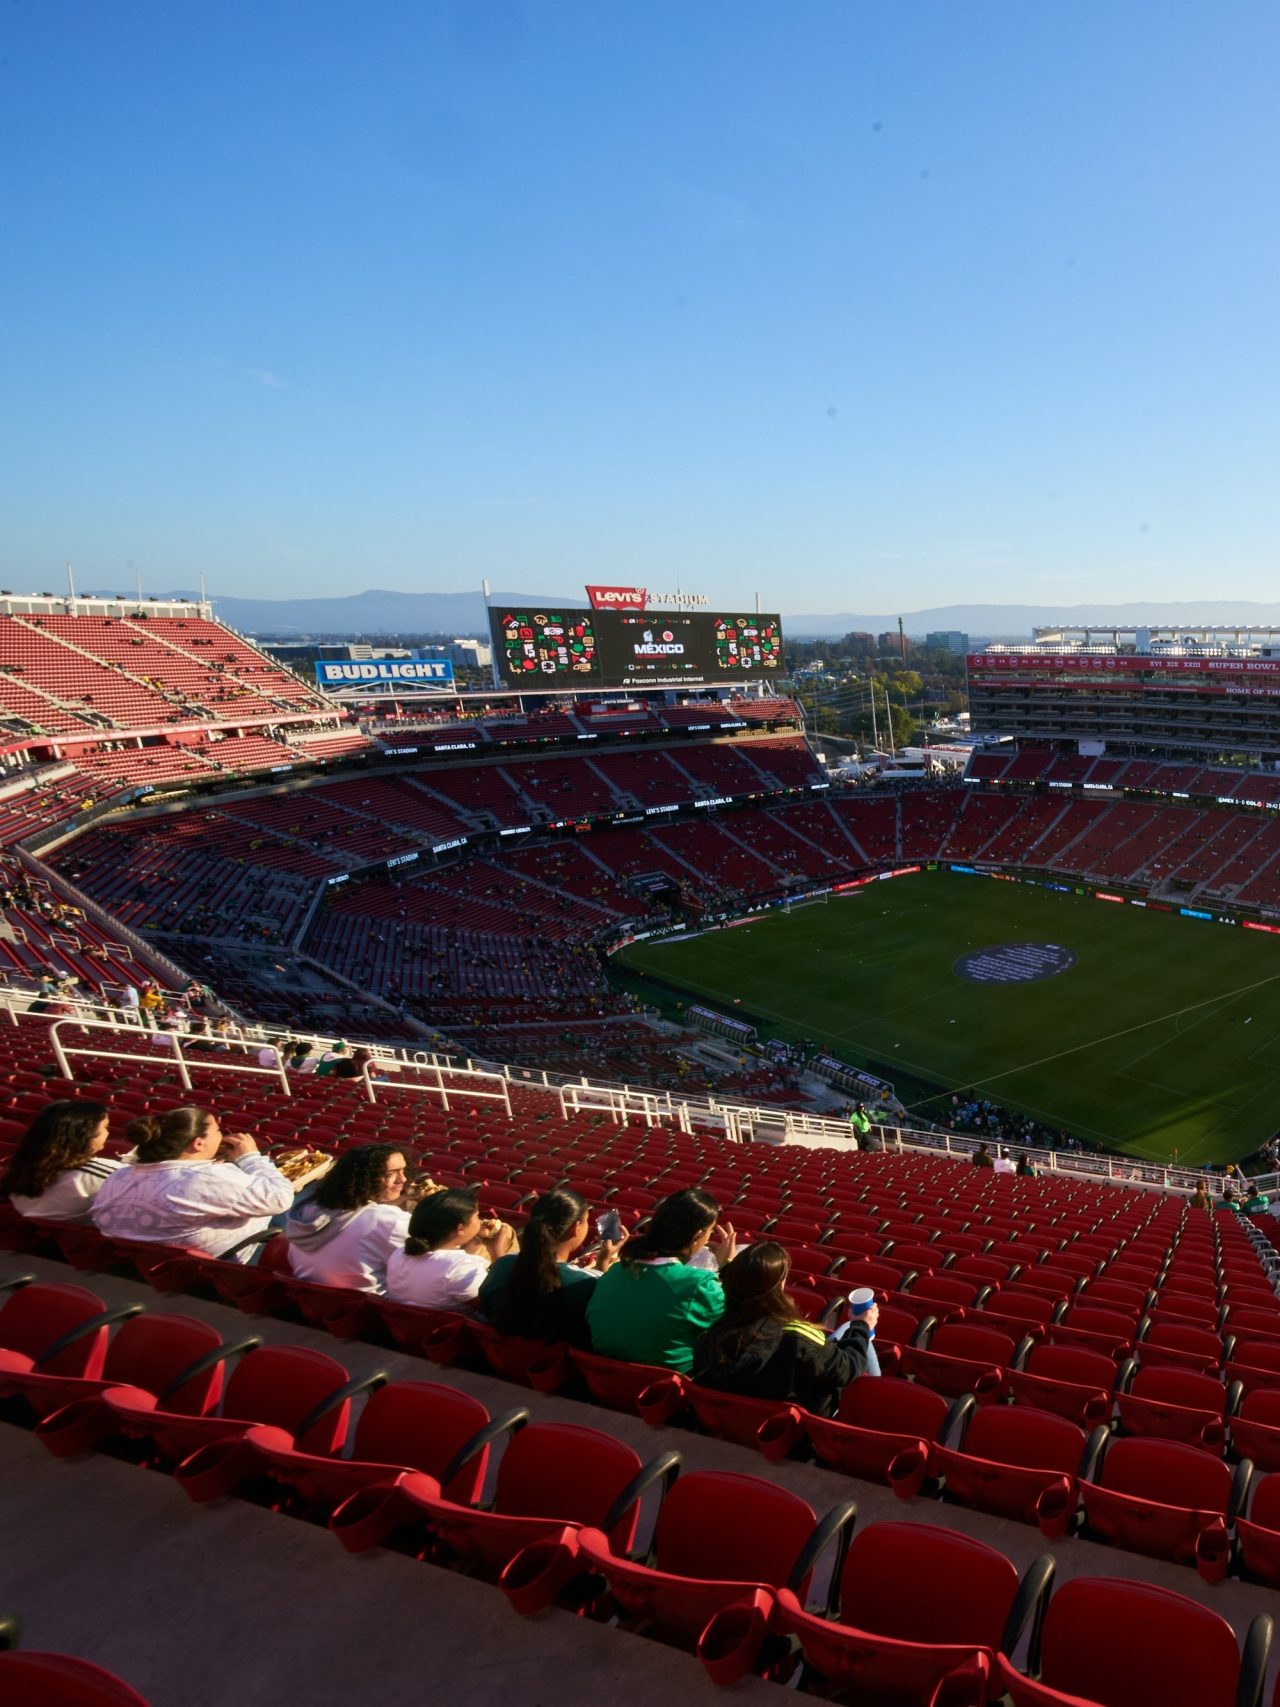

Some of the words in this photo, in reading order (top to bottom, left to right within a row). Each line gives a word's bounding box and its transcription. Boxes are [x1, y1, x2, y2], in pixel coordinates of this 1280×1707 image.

[649, 593, 710, 606] STADIUM
[634, 642, 685, 655] MÉXICO
[1208, 661, 1244, 670] SUPER
[1246, 662, 1279, 671] BOWL
[1226, 687, 1251, 695] HOME
[709, 798, 725, 806] CLARA,
[646, 807, 660, 815] LEVI'S
[660, 804, 679, 813] STADIUM
[400, 852, 419, 864] STADIUM
